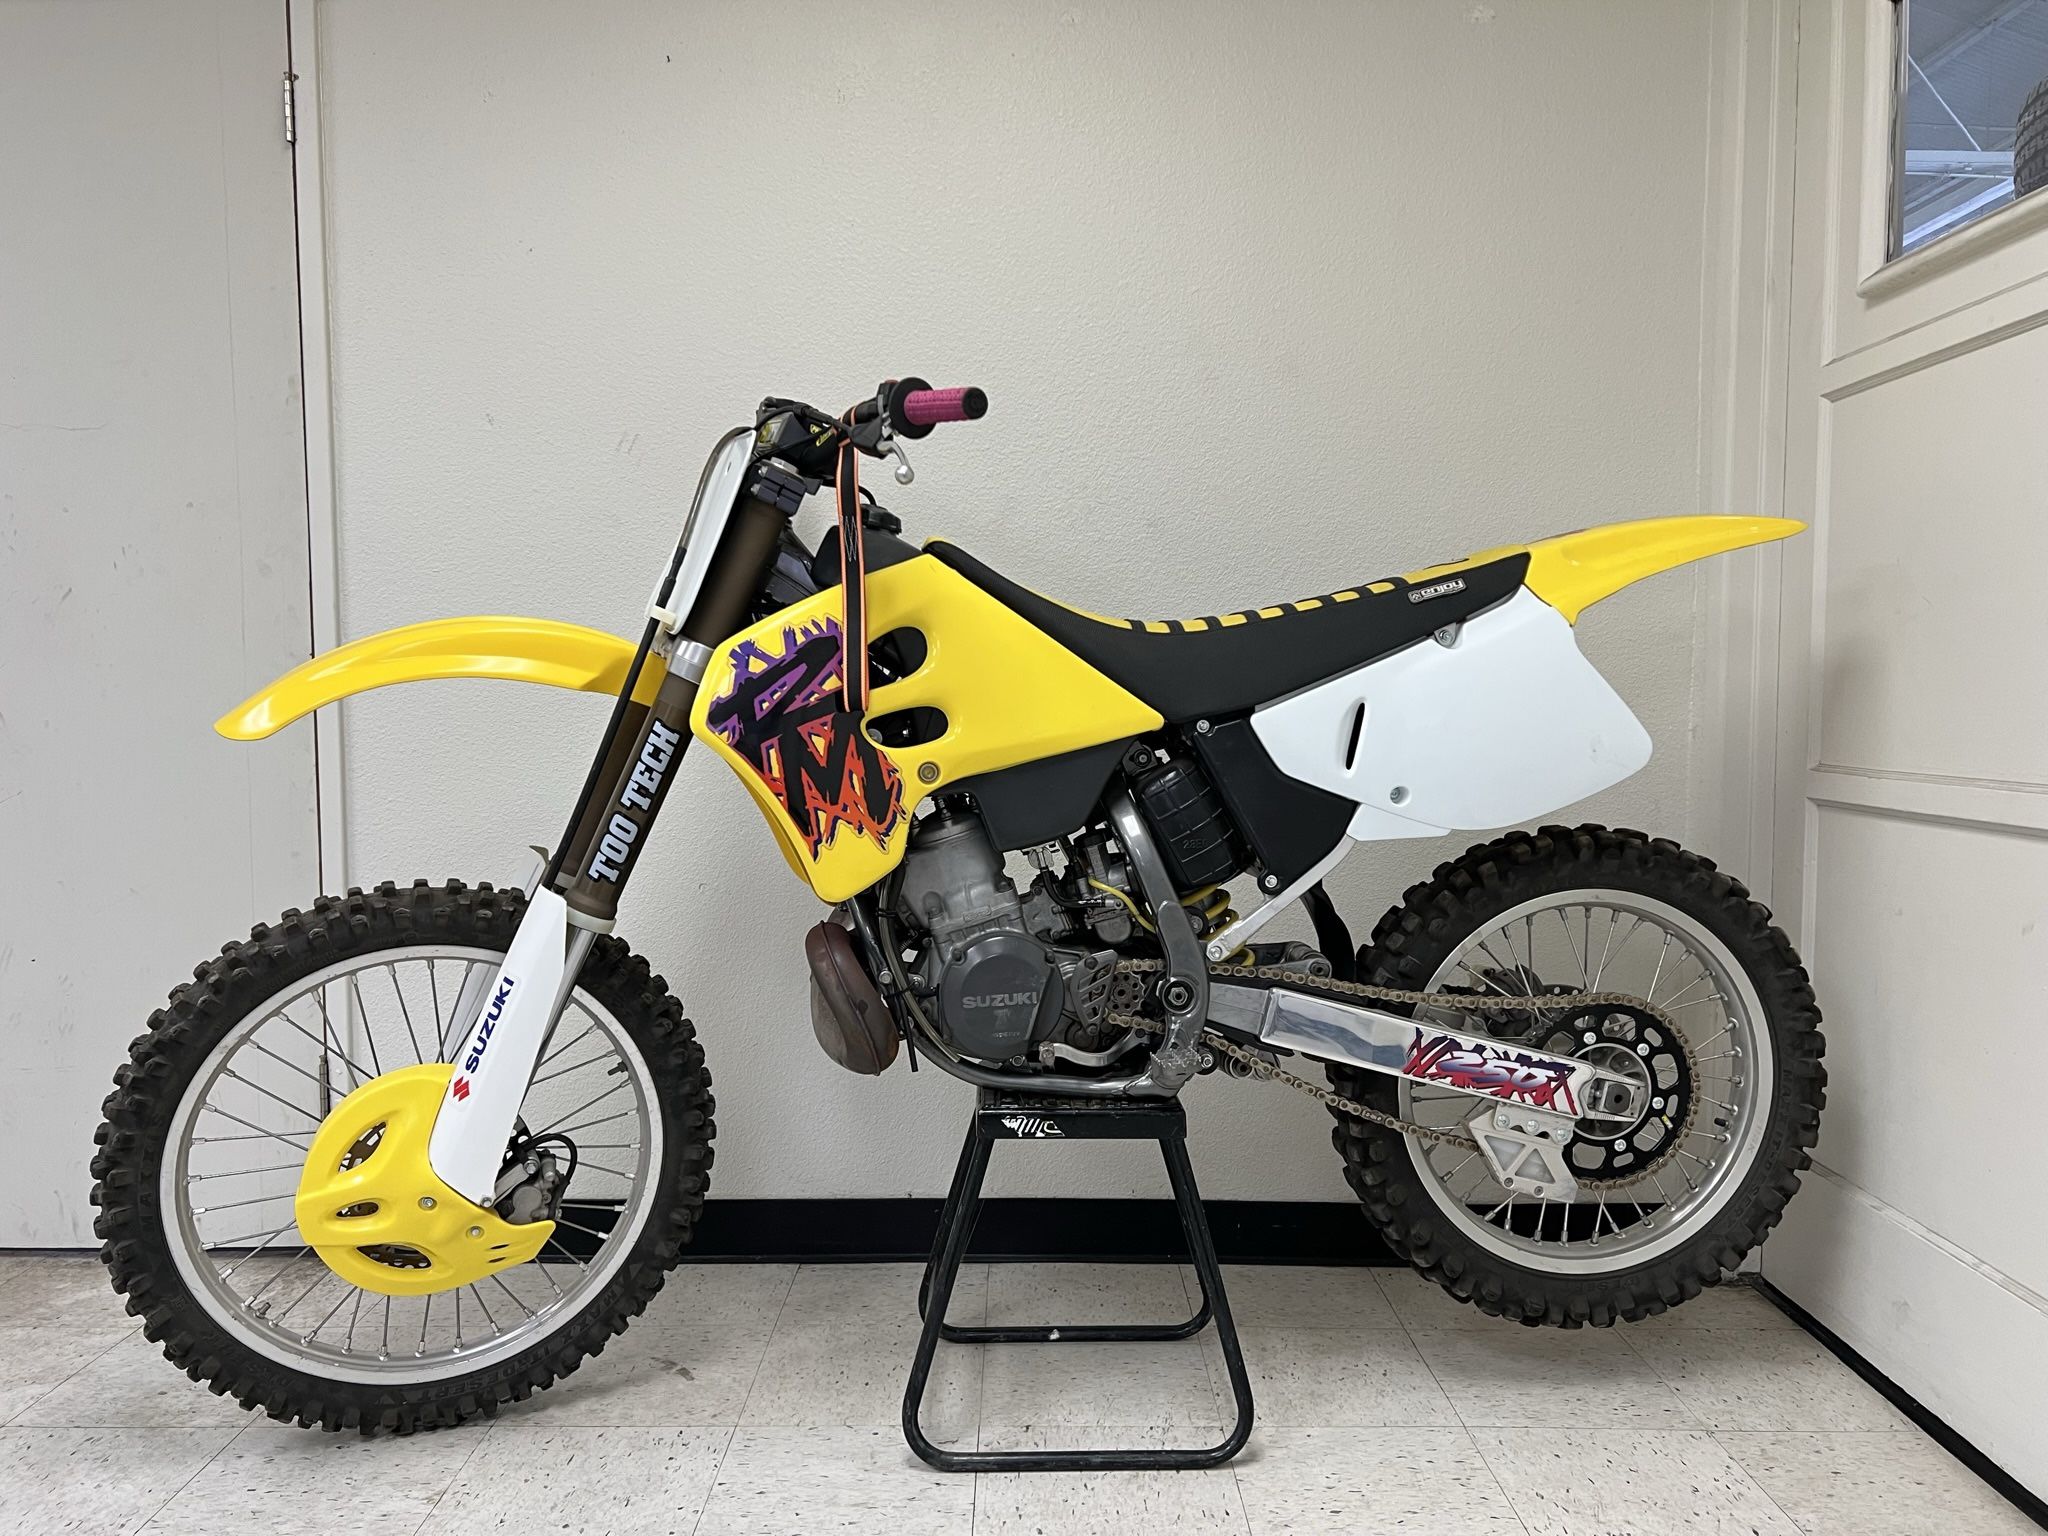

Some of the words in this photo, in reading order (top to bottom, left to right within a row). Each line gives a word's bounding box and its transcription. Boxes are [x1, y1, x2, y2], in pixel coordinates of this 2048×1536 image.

[1421, 580, 1464, 595] enjoy
[707, 616, 907, 862] RM
[588, 813, 638, 884] TOO
[620, 719, 680, 811] TECH
[464, 976, 514, 1073] SUZUKI
[962, 991, 1038, 1009] SUZUKI
[1437, 1050, 1557, 1088] 250
